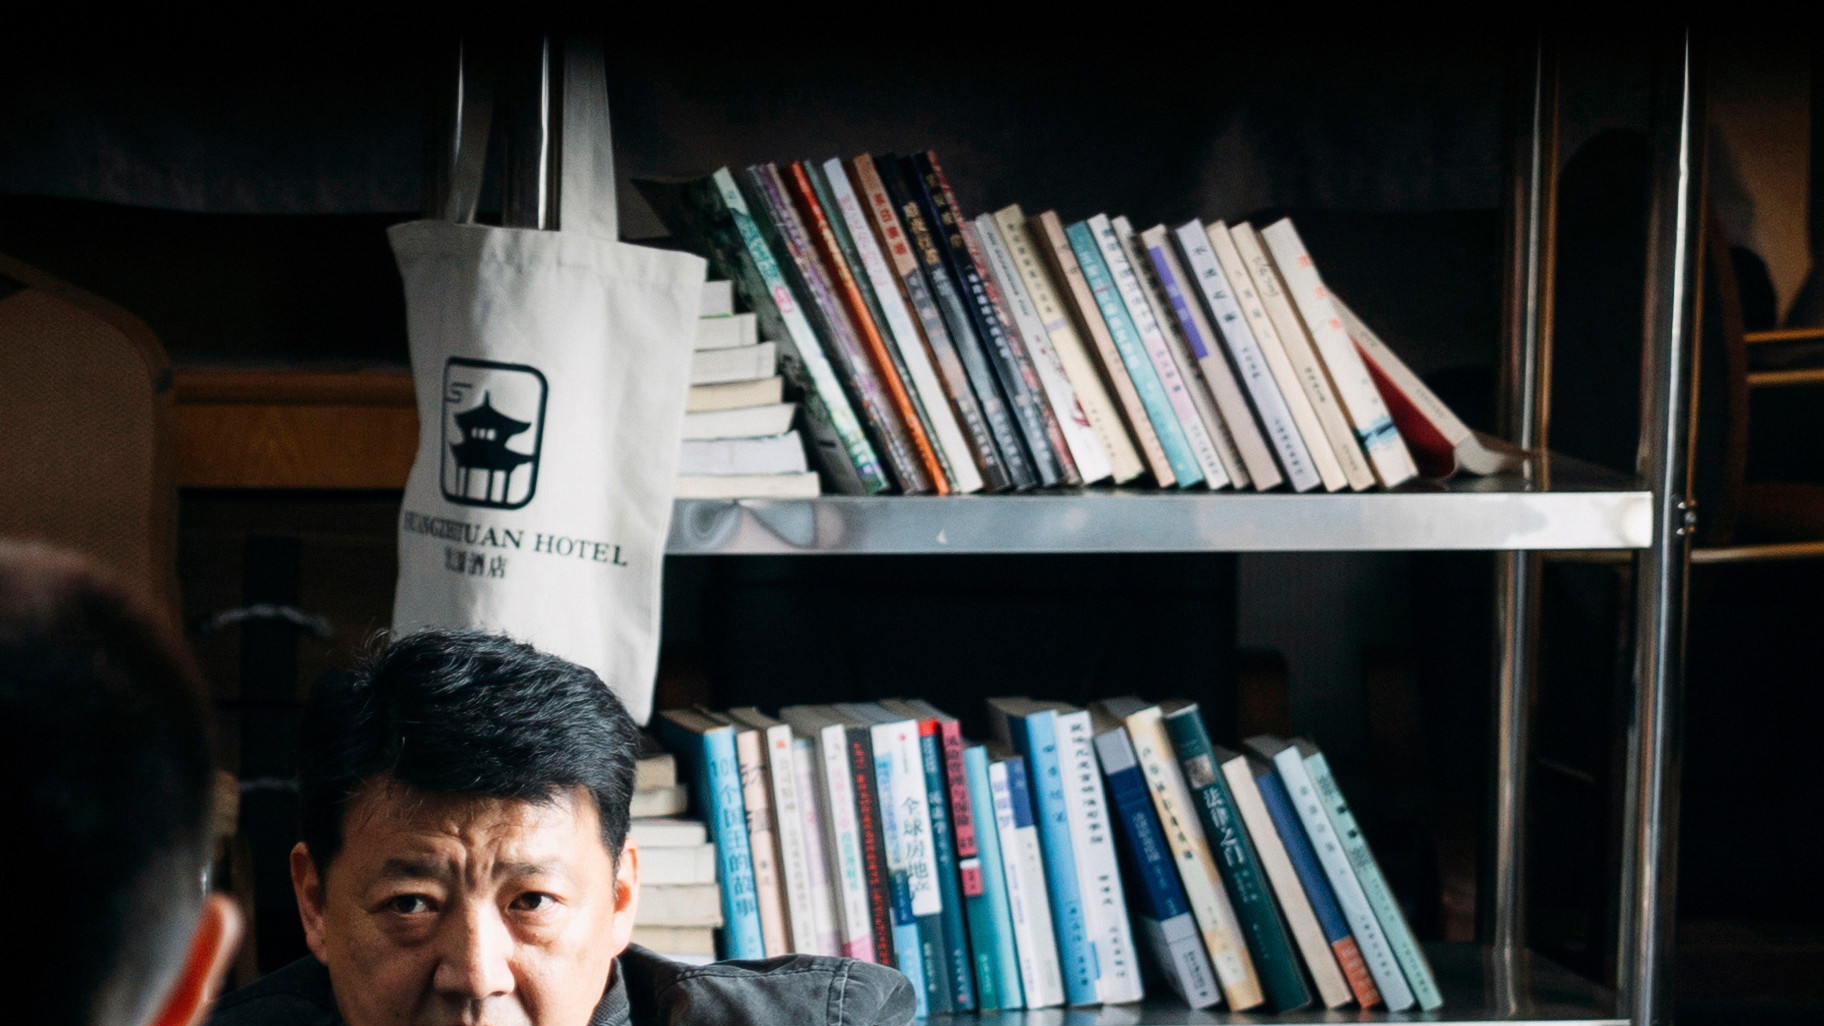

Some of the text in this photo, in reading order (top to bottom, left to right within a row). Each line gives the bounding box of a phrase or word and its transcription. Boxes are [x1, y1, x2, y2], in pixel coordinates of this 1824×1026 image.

[533, 533, 628, 566] HOTEL
[900, 796, 932, 902] 全球房地产
[1200, 784, 1246, 866] 法律之门
